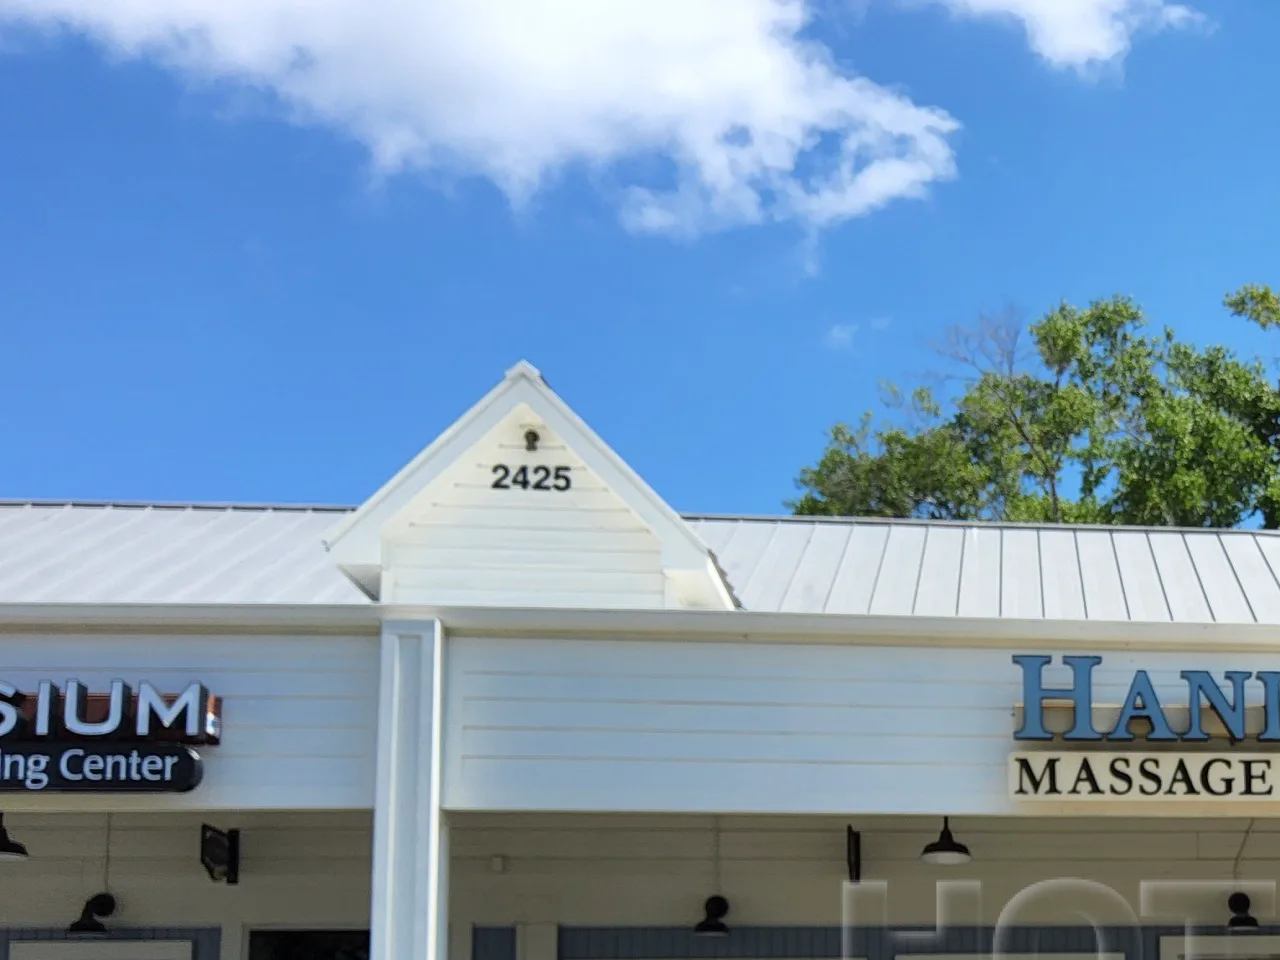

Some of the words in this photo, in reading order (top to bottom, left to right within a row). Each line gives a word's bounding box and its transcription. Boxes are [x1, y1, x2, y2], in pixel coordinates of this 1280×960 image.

[491, 463, 572, 492] 2425
[59, 748, 179, 781] Center
[1014, 757, 1274, 796] MASSAGE
